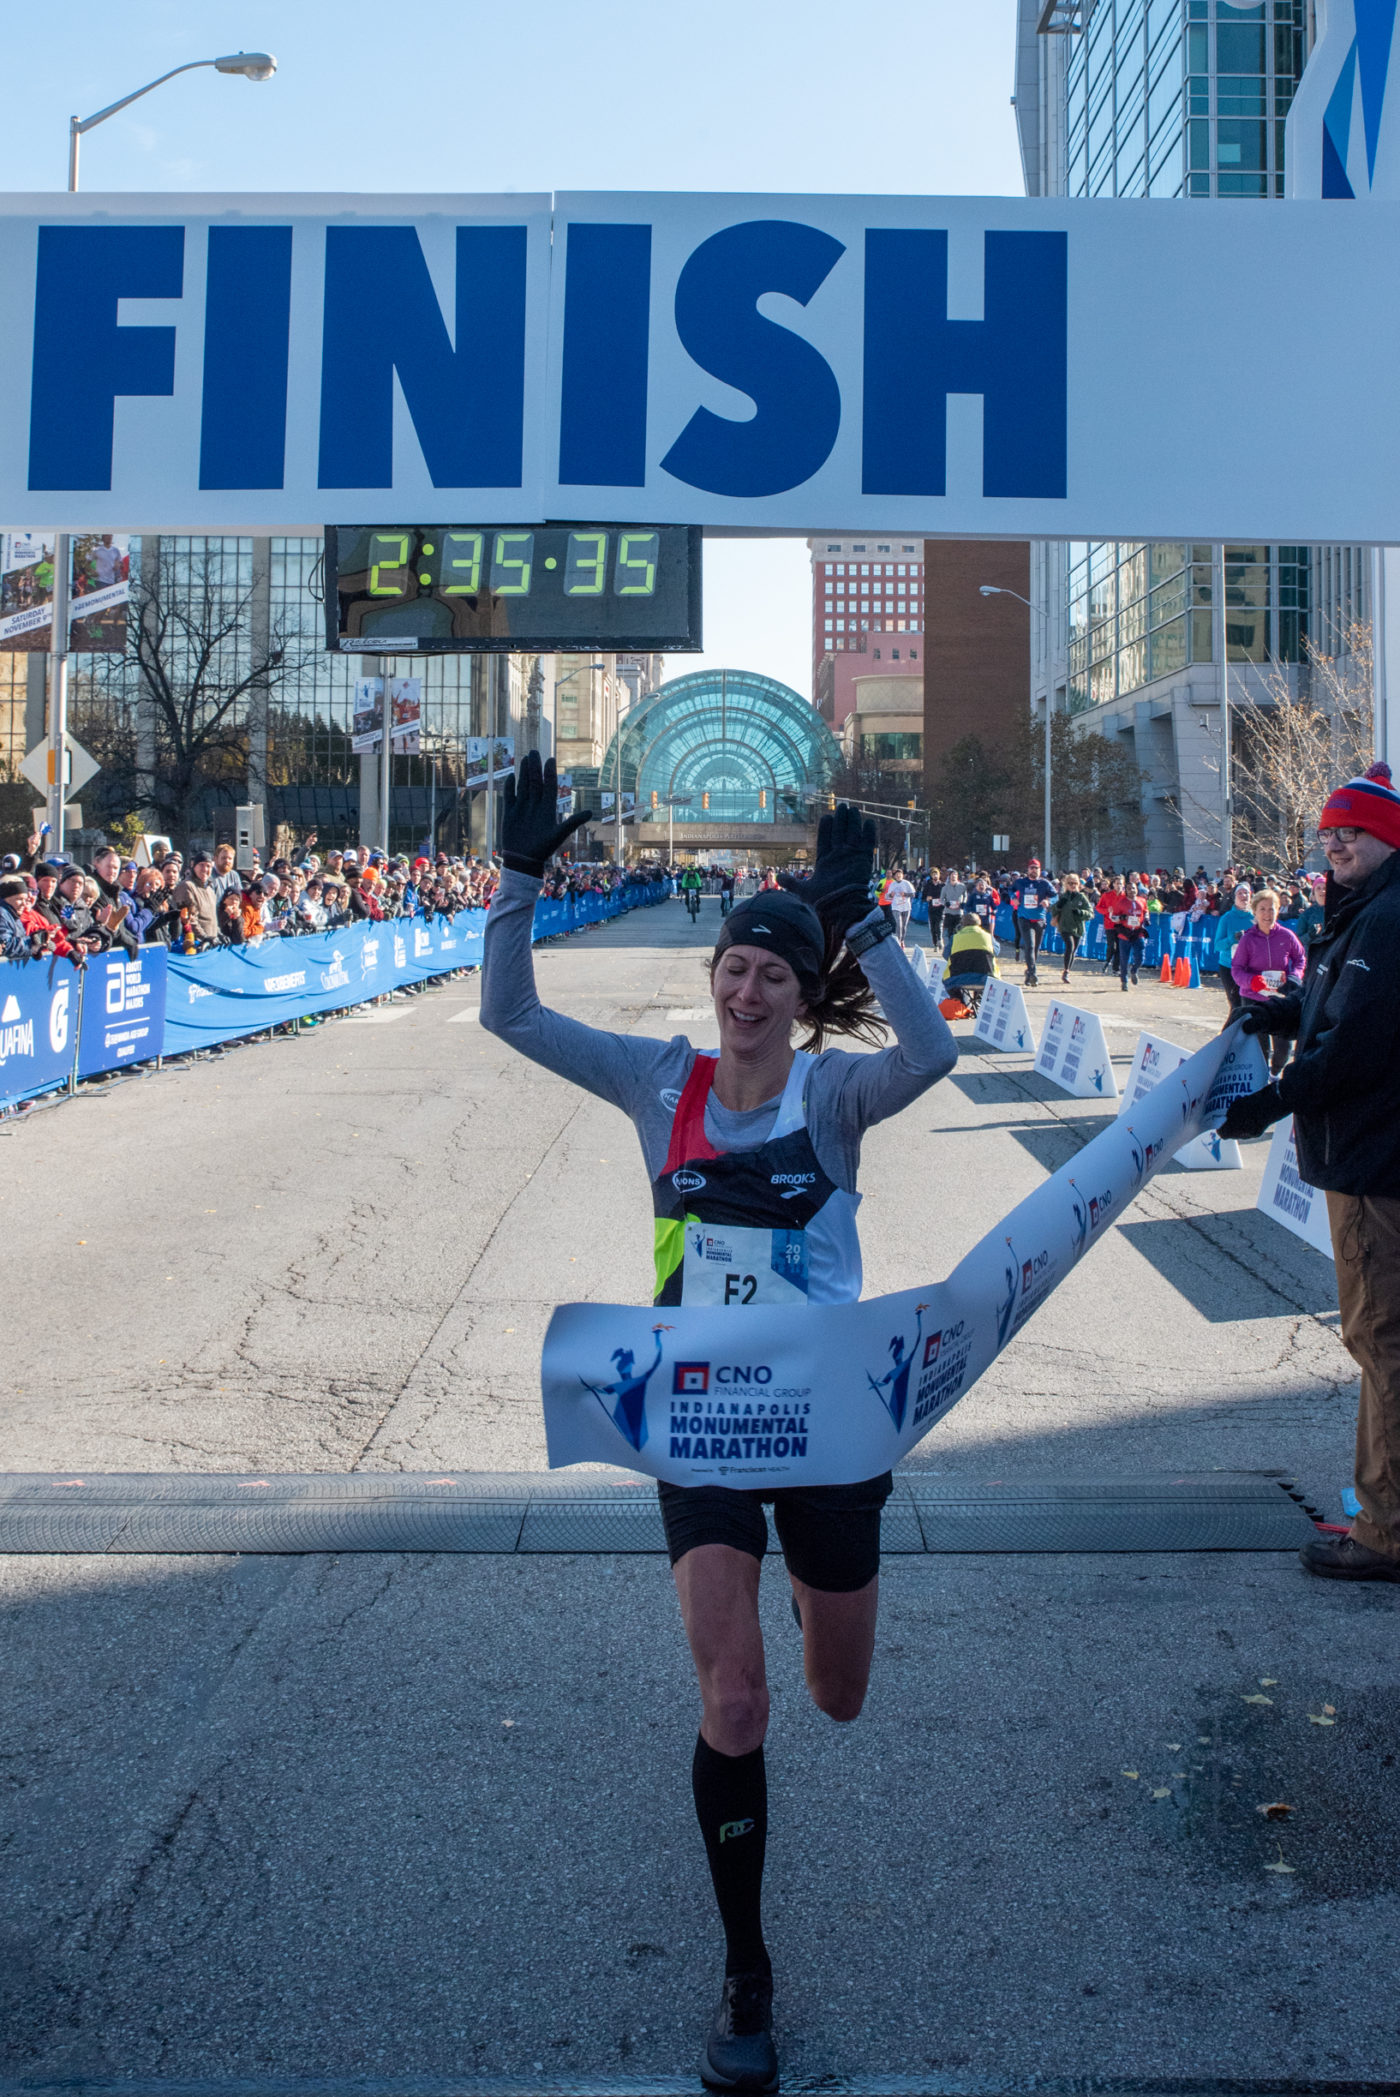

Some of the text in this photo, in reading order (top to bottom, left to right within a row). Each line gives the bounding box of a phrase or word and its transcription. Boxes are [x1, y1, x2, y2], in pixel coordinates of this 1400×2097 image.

[28, 219, 1068, 498] FINISH
[4, 616, 42, 634] NOVEMBER
[12, 607, 45, 624] SATURDAY
[771, 1172, 816, 1185] BROOKS
[1099, 1189, 1112, 1212] CNO
[1273, 1183, 1312, 1224] MARATHON
[786, 1244, 801, 1254] 20
[786, 1254, 801, 1264] 19
[1033, 1250, 1049, 1275] CNO
[724, 1273, 758, 1305] F2
[942, 1320, 965, 1347] CNO
[715, 1365, 773, 1385] CNO
[714, 1387, 812, 1398] FINANCIAL GROUP
[912, 1371, 965, 1427] MARATHON
[670, 1401, 811, 1416] INDIANAPOLIS
[670, 1415, 808, 1435] MONUMENTAL
[669, 1436, 808, 1460] MARATHON
